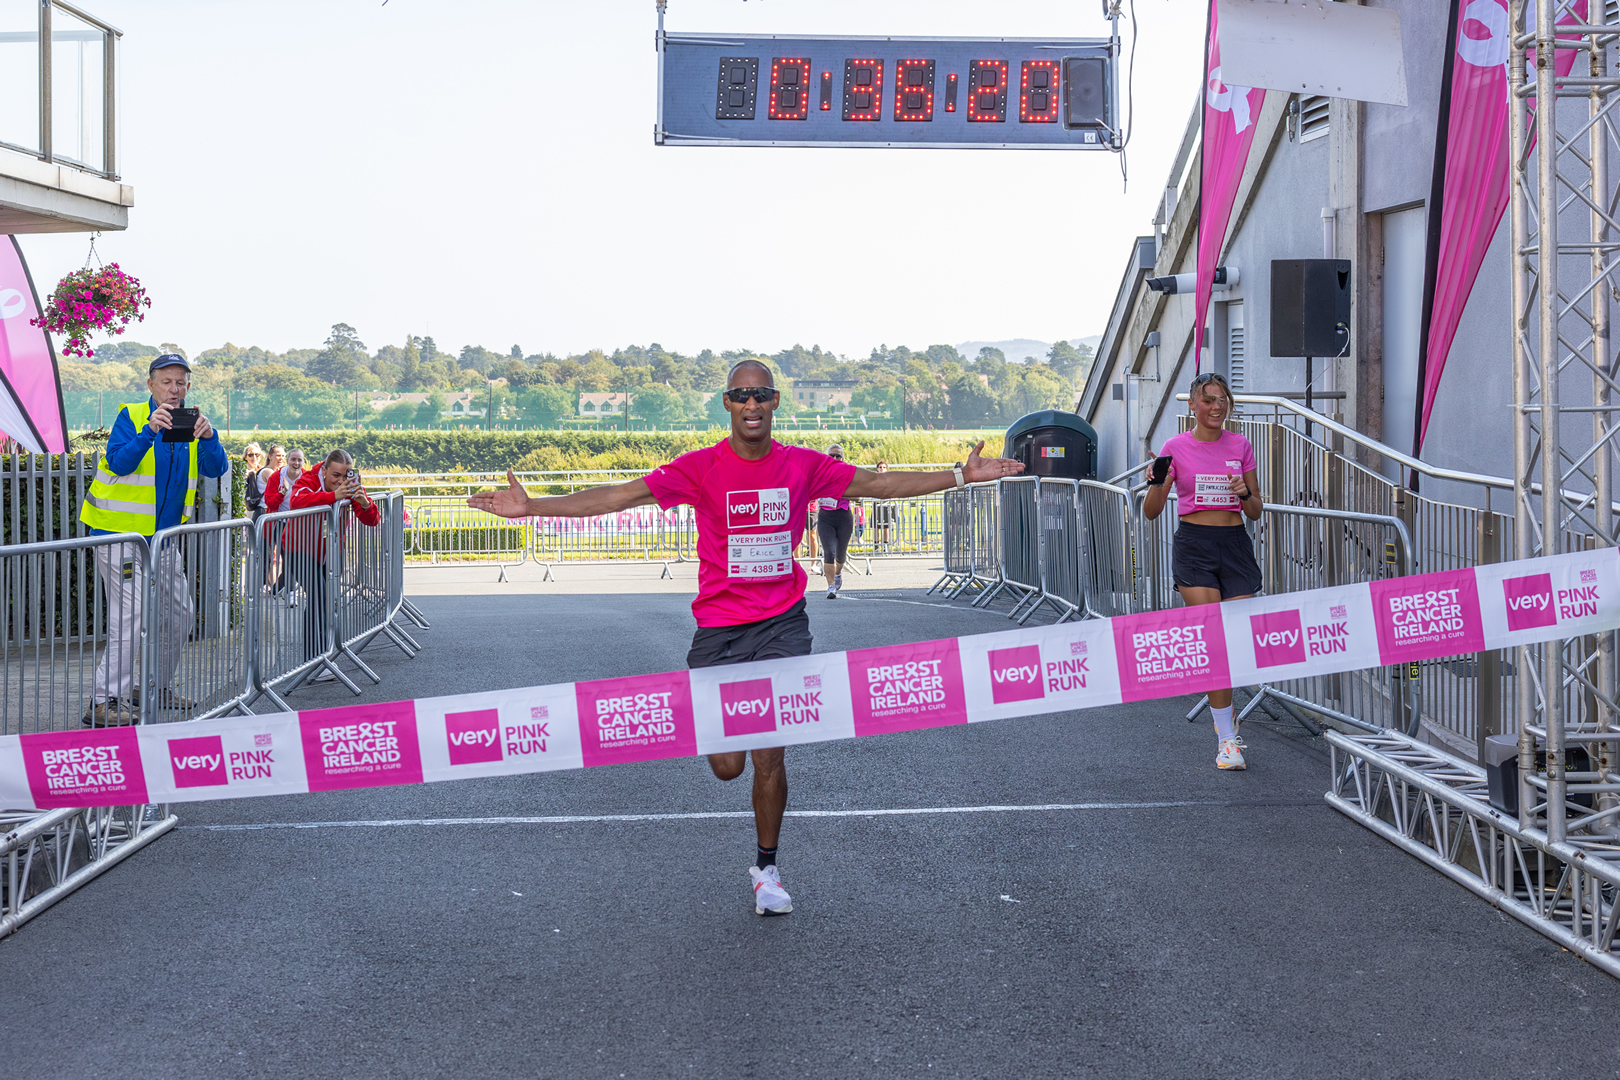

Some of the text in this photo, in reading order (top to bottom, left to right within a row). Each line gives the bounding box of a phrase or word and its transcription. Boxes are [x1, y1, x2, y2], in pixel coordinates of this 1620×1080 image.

[730, 503, 758, 515] very
[763, 501, 787, 511] PINK
[763, 512, 785, 521] RUN
[752, 565, 773, 573] 4389
[1389, 589, 1459, 612] BREAST
[1509, 592, 1549, 611] very
[1558, 585, 1600, 604] PINK
[1392, 605, 1462, 625] CANCER
[1560, 602, 1597, 619] RUN
[1133, 625, 1204, 648] BREAST
[1307, 622, 1349, 640] PINK
[1394, 618, 1463, 638] IRELAND
[1256, 629, 1298, 648] very
[1309, 638, 1346, 656] RUN
[1395, 634, 1439, 646] researching
[1135, 641, 1207, 662] CANCER
[867, 659, 941, 683] BREAST
[1047, 657, 1090, 676] PINK
[1137, 655, 1209, 675] IRELAND
[994, 665, 1038, 684] very
[1049, 674, 1086, 692] RUN
[1138, 671, 1183, 682] researching
[869, 676, 943, 696] CANCER
[596, 692, 672, 714] BREAST
[725, 698, 770, 717] very
[779, 691, 823, 710] PINK
[870, 690, 945, 710] IRELAND
[598, 708, 673, 728] CANCER
[781, 708, 819, 725] RUN
[872, 706, 918, 717] researching
[320, 721, 396, 742] BREAST
[450, 728, 496, 747] very
[506, 723, 550, 740] PINK
[599, 722, 675, 741] IRELAND
[322, 737, 398, 755] CANCER
[507, 739, 546, 755] RUN
[600, 738, 648, 748] researching
[42, 746, 119, 764] BREAST
[174, 754, 220, 771] very
[230, 750, 275, 765] PINK
[324, 750, 400, 768] IRELAND
[46, 760, 122, 777] CANCER
[232, 765, 271, 780] RUN
[325, 765, 373, 774] researching
[48, 773, 125, 789] IRELAND
[50, 786, 98, 795] researching
